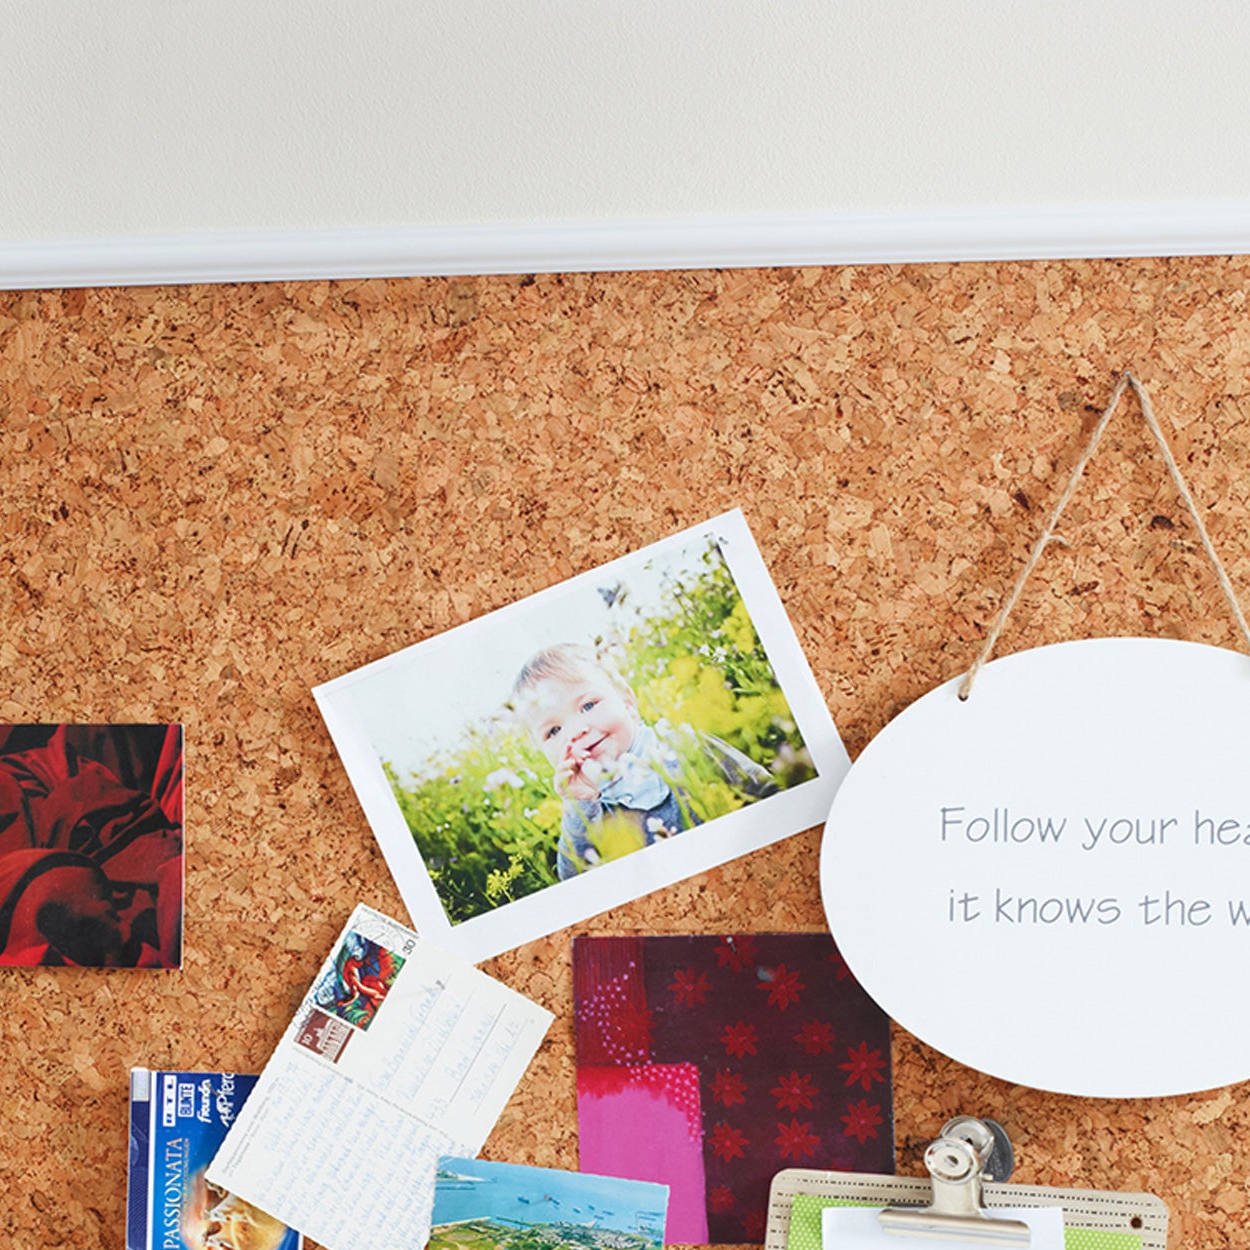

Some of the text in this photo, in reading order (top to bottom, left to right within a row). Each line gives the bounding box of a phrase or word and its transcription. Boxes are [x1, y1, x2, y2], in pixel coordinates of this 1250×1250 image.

[940, 807, 1067, 843] Follow
[1082, 818, 1178, 851] your
[949, 888, 981, 923] it
[995, 888, 1121, 925] knows
[1138, 890, 1212, 926] the
